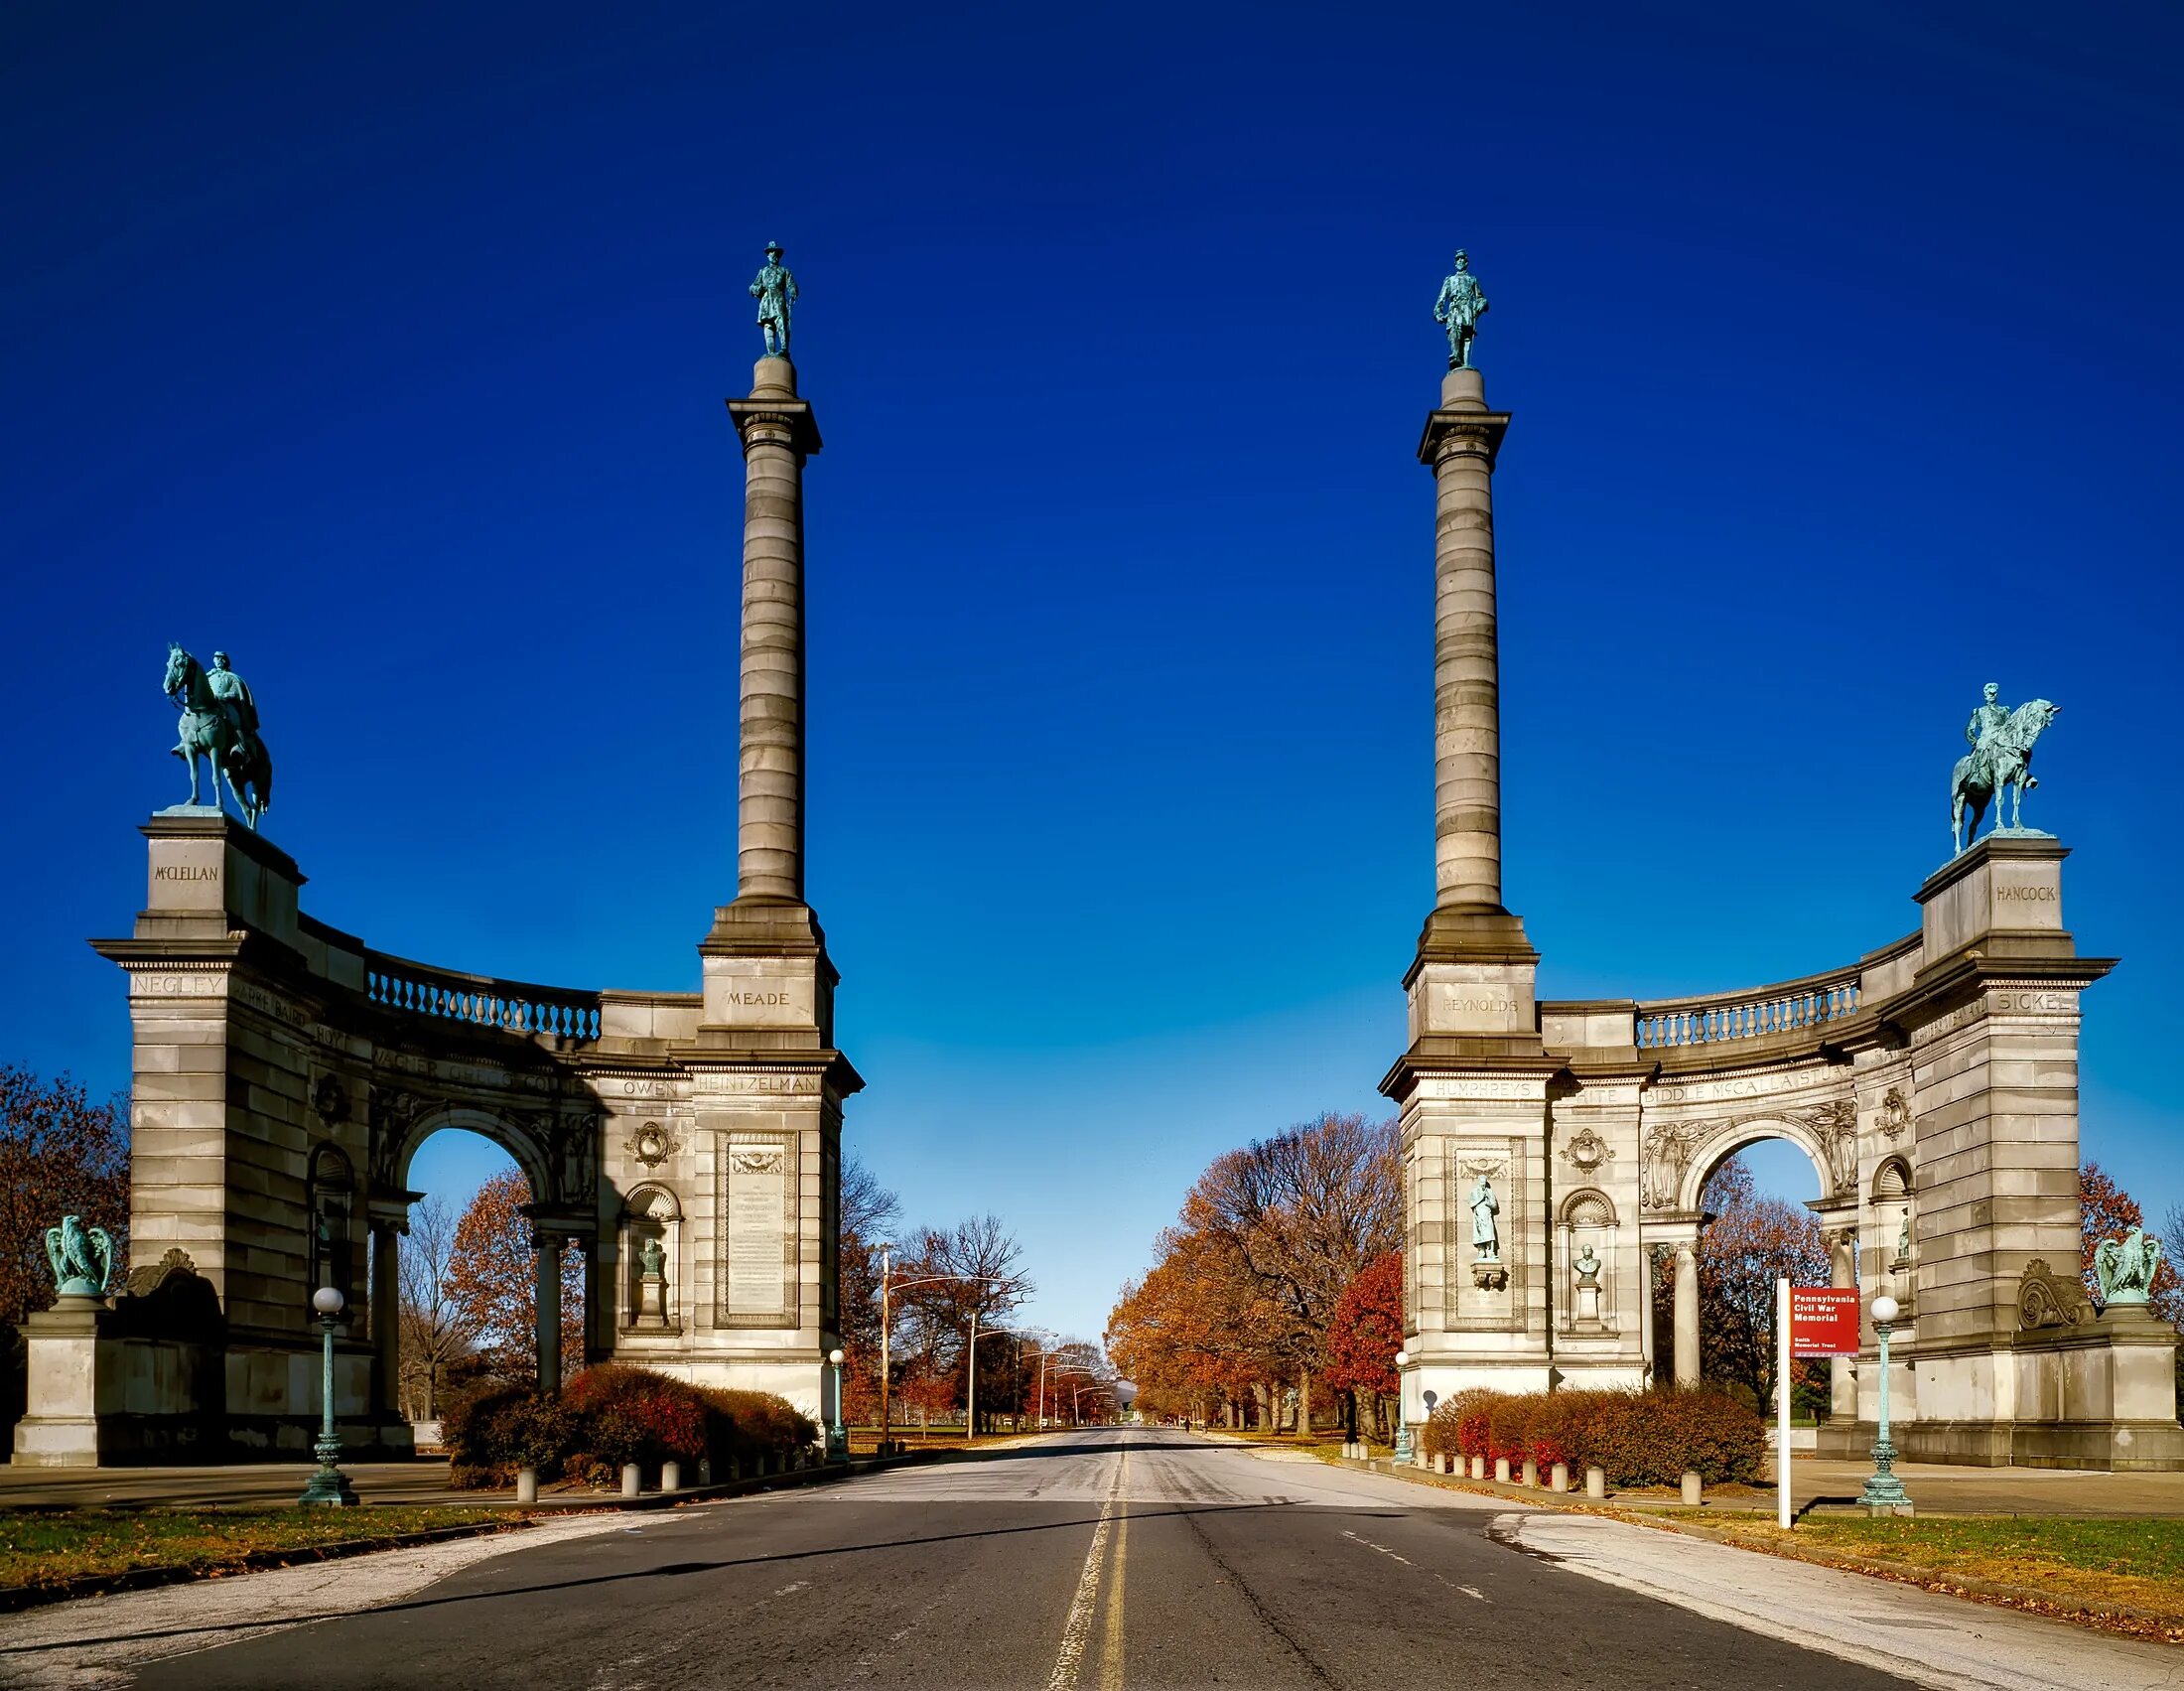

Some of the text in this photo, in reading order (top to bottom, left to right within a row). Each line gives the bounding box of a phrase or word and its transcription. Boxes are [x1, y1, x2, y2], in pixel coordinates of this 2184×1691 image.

[1996, 887, 2056, 901] HANCOCK
[133, 976, 222, 993] NEGLEY
[728, 992, 790, 1006] MEADE
[1442, 999, 1519, 1013] REYNOLDS
[275, 999, 306, 1028] BAIRD
[317, 1026, 349, 1050] HOYT
[623, 1081, 678, 1097] OWEN
[698, 1075, 817, 1092] HEINTZELMAN
[1435, 1081, 1532, 1097] HUMPHREYS
[1644, 1085, 1705, 1103] BIDDLE
[1794, 1295, 1855, 1304] Pennsylvania
[1794, 1304, 1837, 1313] Civil War
[1794, 1314, 1839, 1323] Memorial
